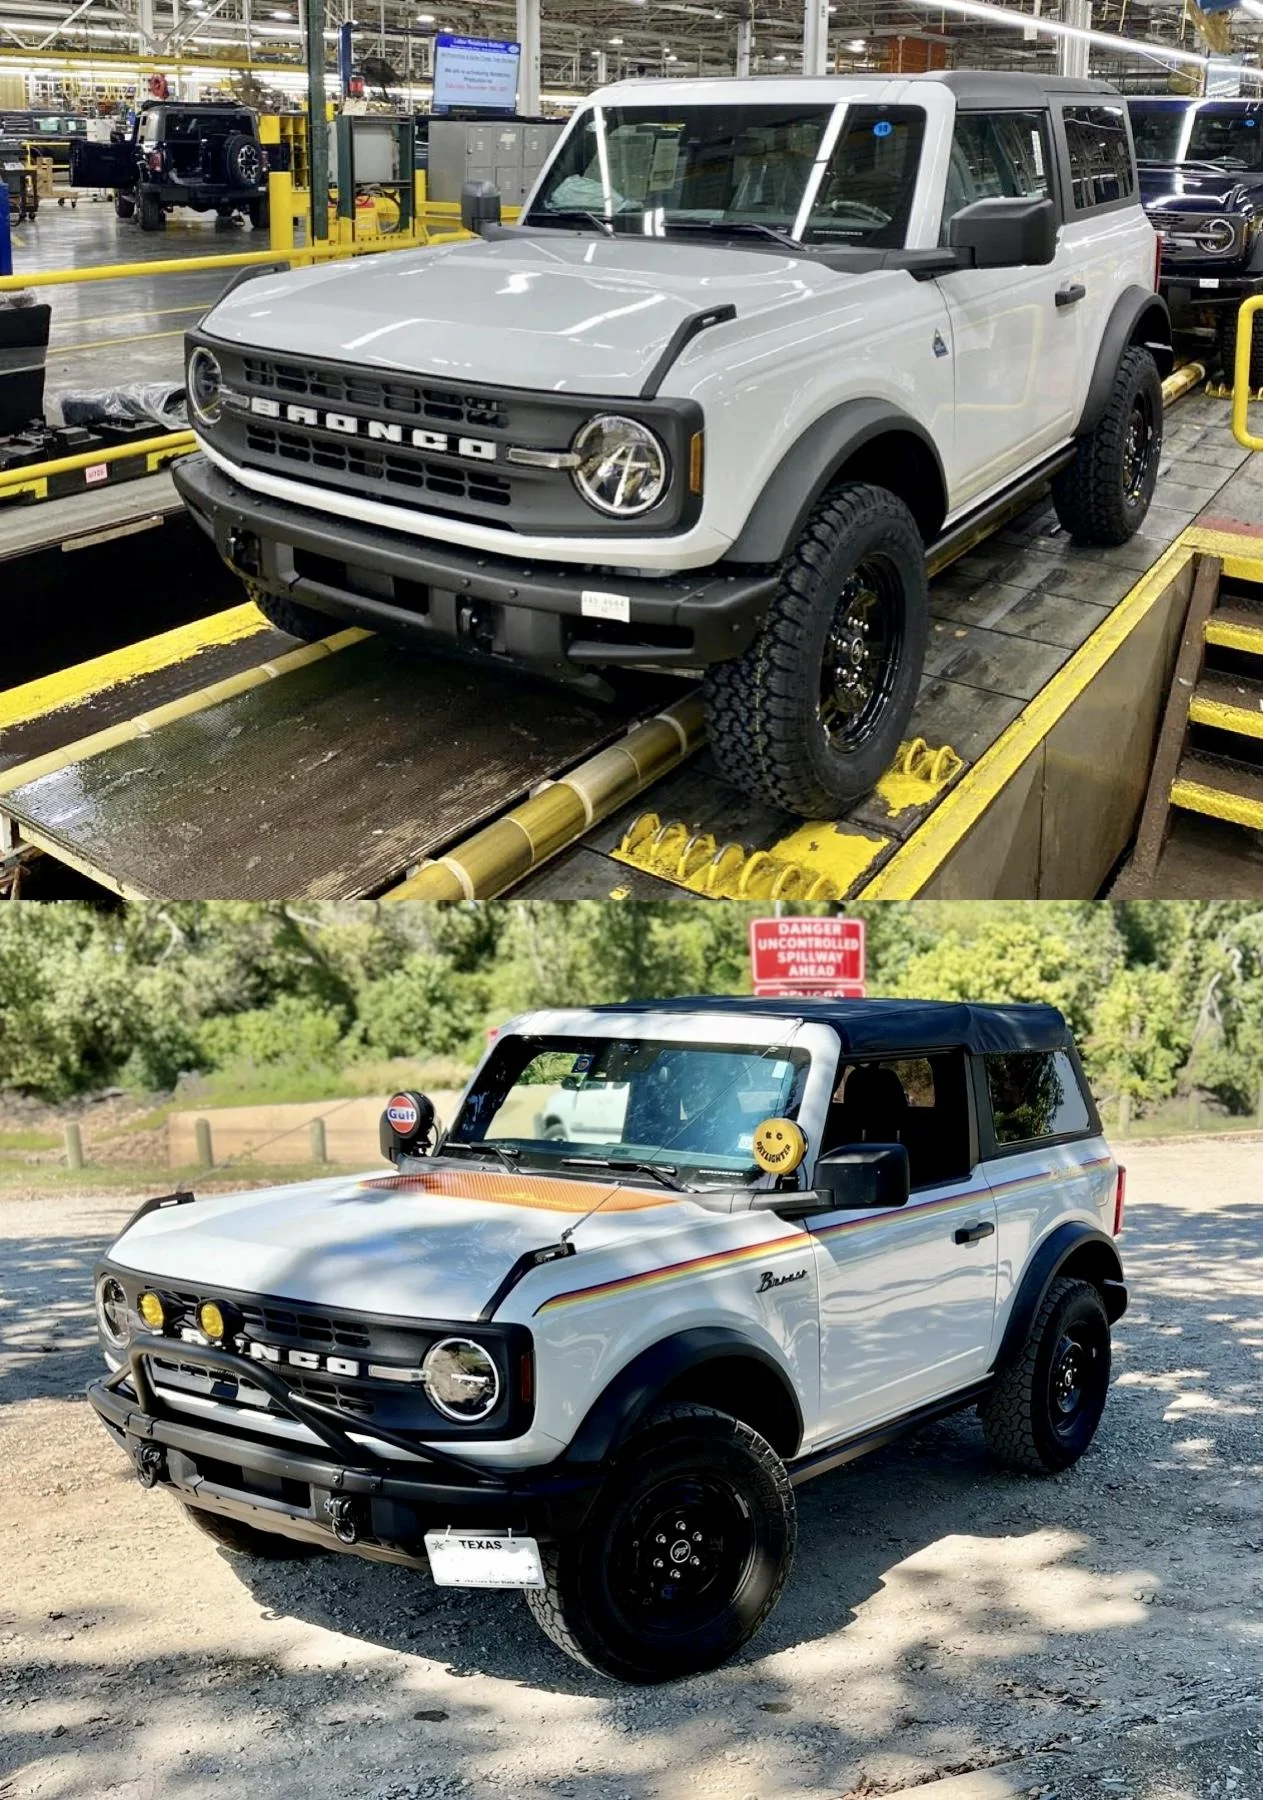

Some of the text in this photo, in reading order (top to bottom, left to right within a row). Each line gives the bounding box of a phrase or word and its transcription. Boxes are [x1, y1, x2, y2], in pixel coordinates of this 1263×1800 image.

[251, 396, 497, 460] BRONCO
[778, 923, 842, 936] DANGER
[758, 938, 860, 951] UNCONTROLLED
[777, 952, 844, 964] SPILLWAY
[788, 965, 836, 976] AHEAD
[389, 1108, 415, 1120] Gulf
[756, 1141, 791, 1163] DAYLIGHTER
[458, 1540, 502, 1550] TEXAS
